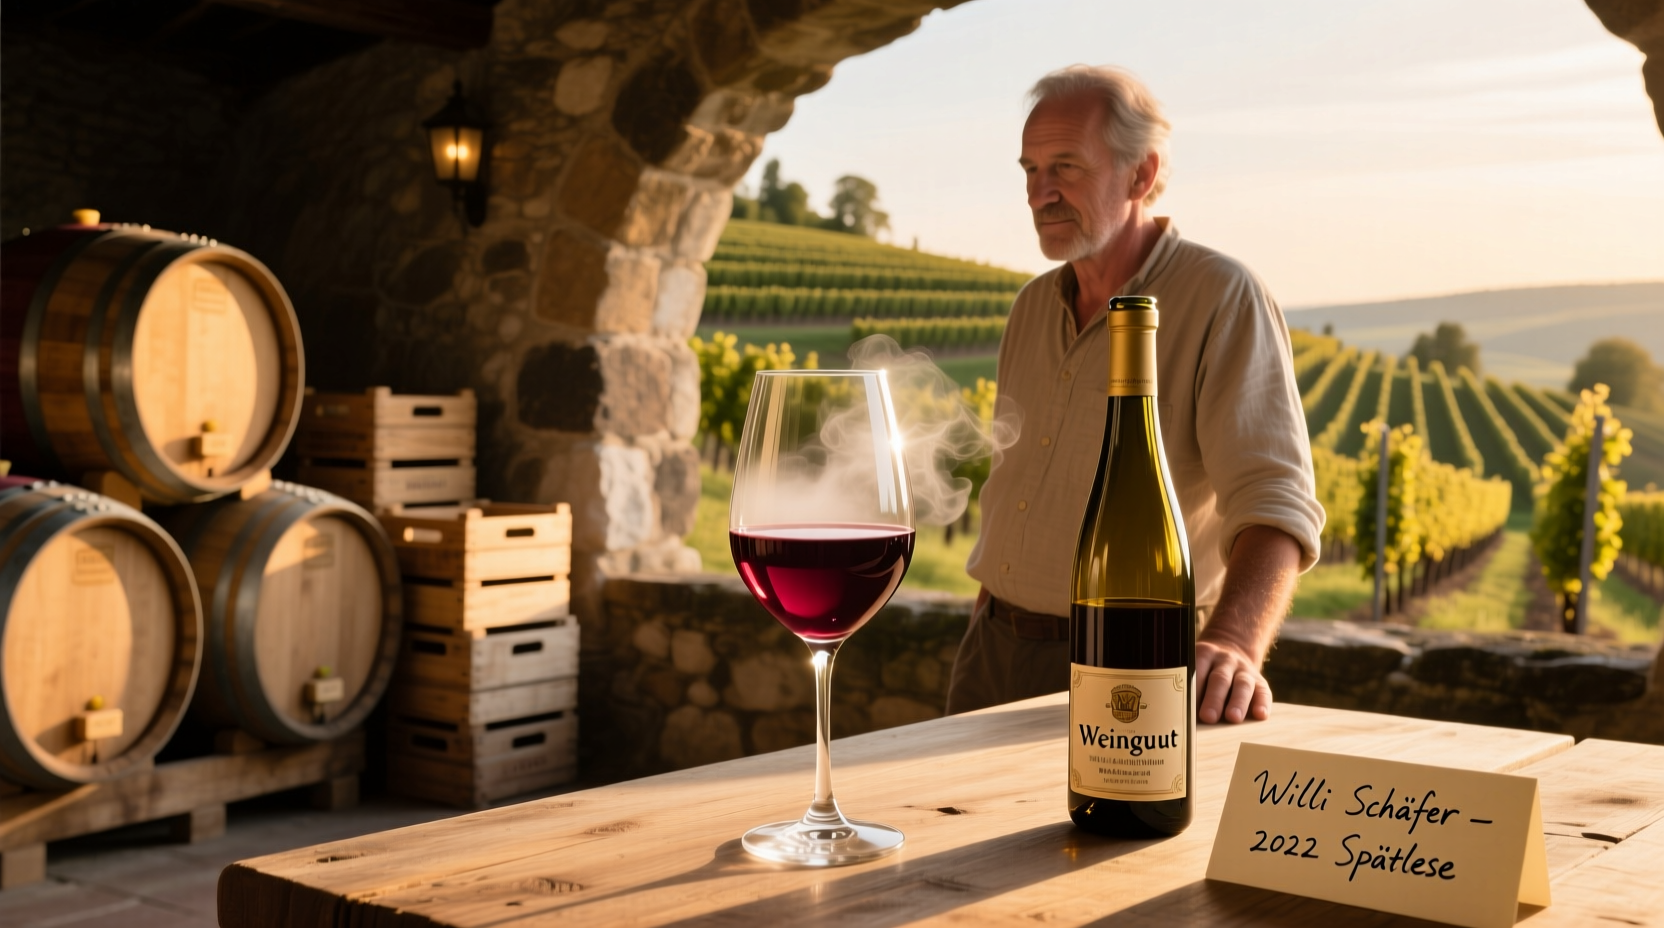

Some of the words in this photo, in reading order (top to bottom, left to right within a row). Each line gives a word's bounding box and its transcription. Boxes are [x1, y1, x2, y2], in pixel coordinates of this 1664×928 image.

[1079, 723, 1179, 757] Weinguut
[1253, 770, 1332, 811] Willi
[1345, 784, 1460, 835] Schäfer
[1249, 830, 1319, 859] 2022
[1334, 834, 1456, 882] Spätlese
